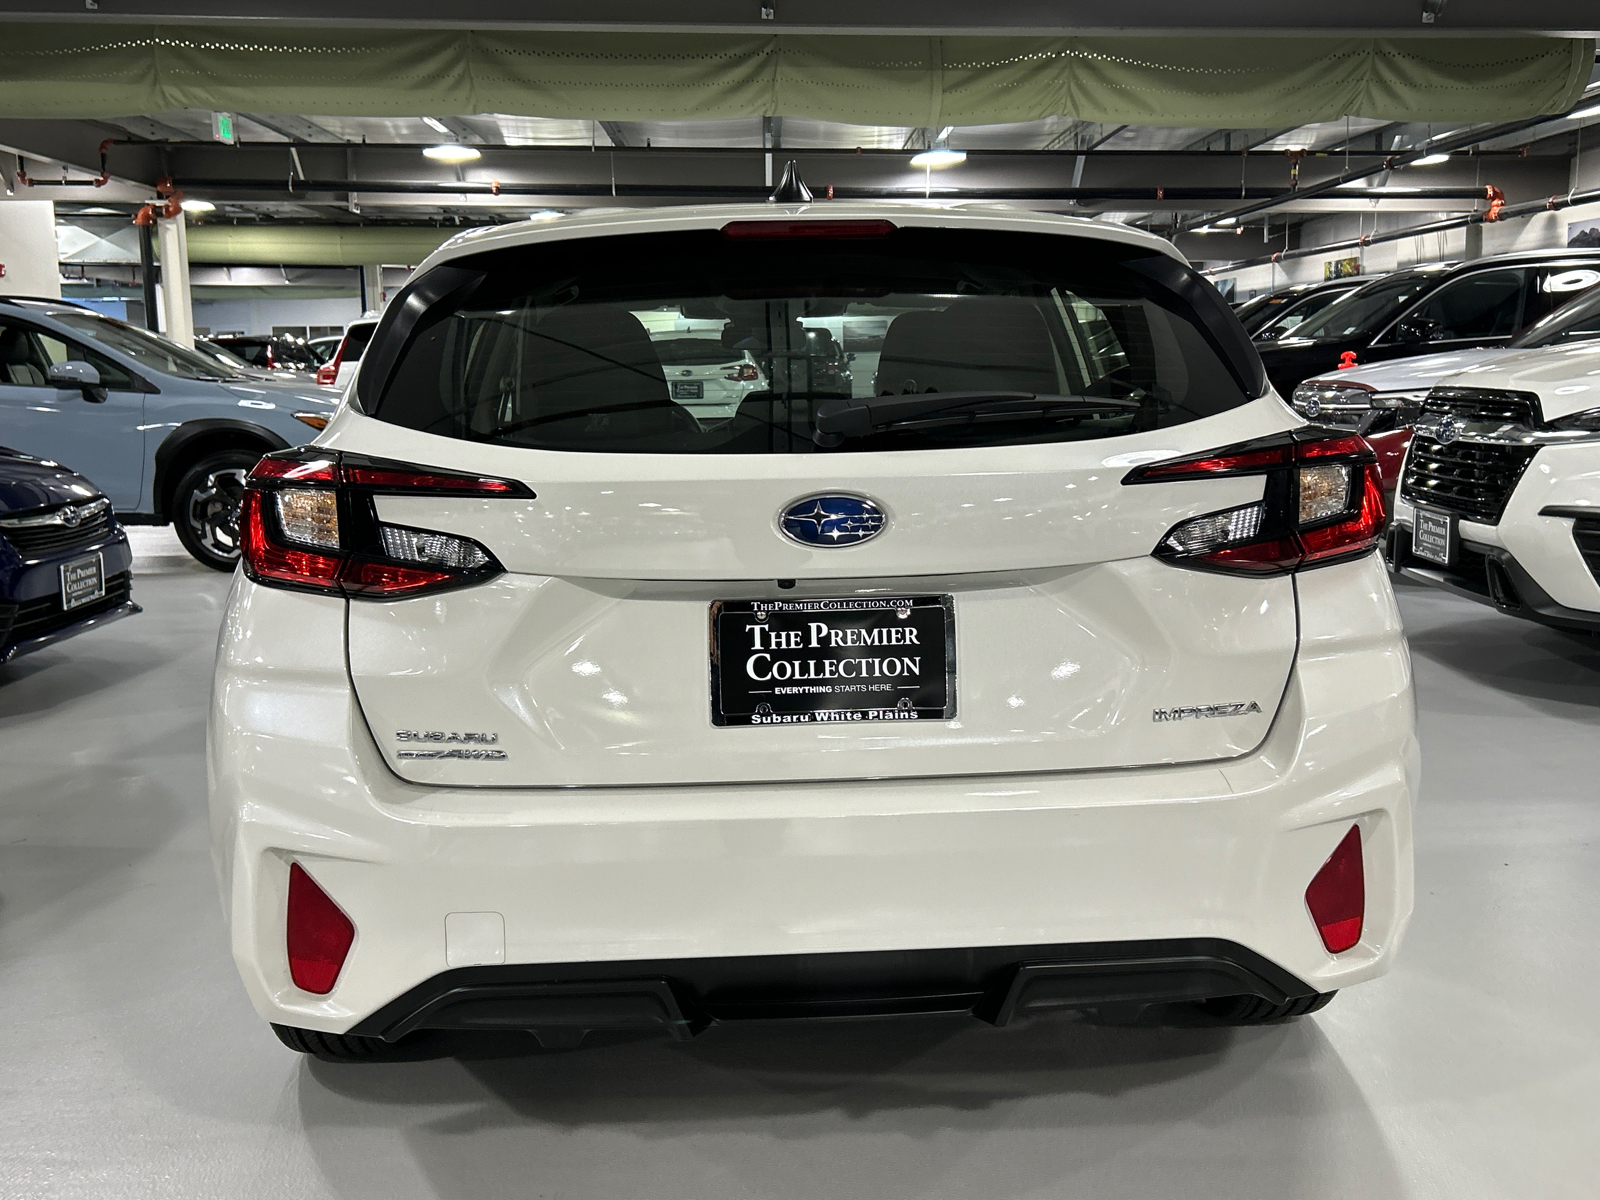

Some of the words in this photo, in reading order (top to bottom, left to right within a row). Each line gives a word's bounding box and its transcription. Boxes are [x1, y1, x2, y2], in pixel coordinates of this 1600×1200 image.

[745, 624, 804, 650] THE
[808, 622, 921, 648] PREMIER
[746, 653, 921, 681] COLLECTION
[774, 686, 833, 695] EVERYTHING
[834, 684, 867, 693] STARTS
[868, 683, 895, 692] HERE.
[751, 713, 810, 725] Subaru
[815, 711, 862, 722] White
[868, 709, 919, 721] Plains
[1153, 701, 1262, 722] IMPREZA
[396, 730, 498, 745] SUBARU
